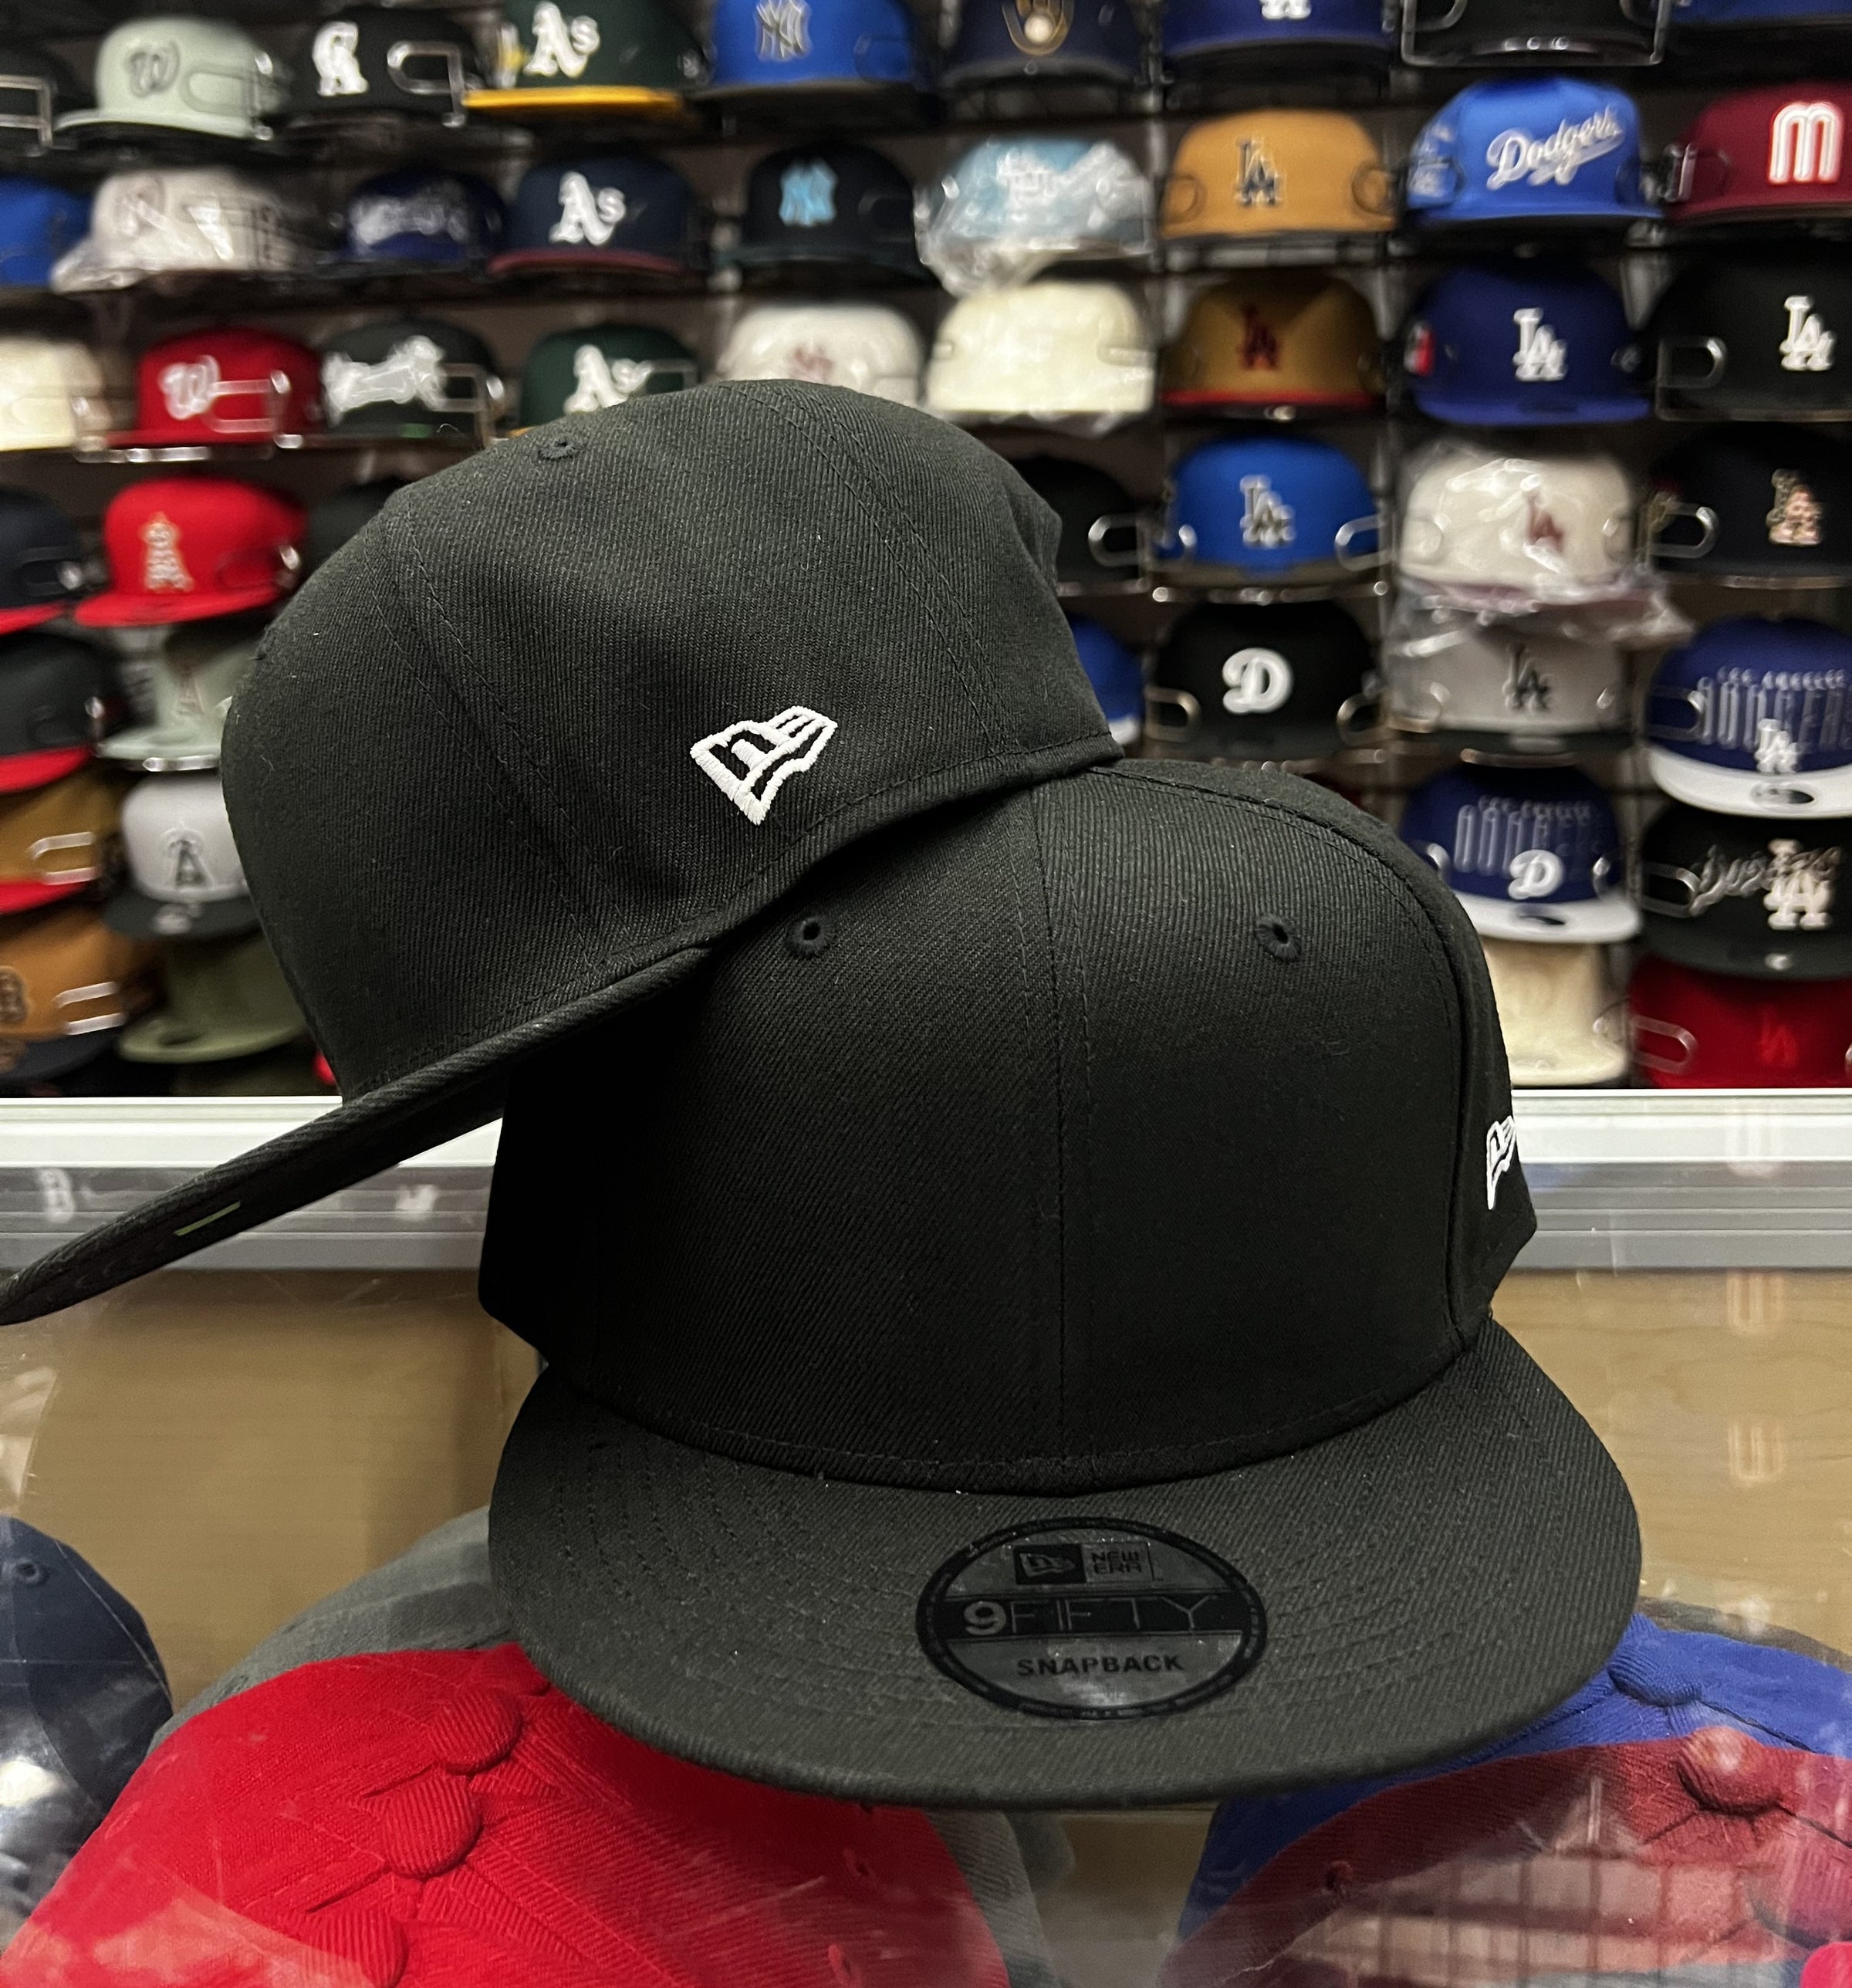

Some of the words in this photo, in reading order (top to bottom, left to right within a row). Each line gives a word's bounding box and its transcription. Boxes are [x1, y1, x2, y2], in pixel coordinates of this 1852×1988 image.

[1237, 135, 1283, 208] LA
[1486, 103, 1624, 190] Dodgers
[1512, 307, 1568, 381] LA
[1779, 295, 1837, 371] LA
[1239, 474, 1296, 549] LA
[1222, 647, 1293, 714] D
[1754, 718, 1801, 776] LA
[1508, 849, 1563, 900] D
[1090, 1550, 1140, 1562] NEW
[962, 1594, 1219, 1636] 9FIFTY
[1016, 1654, 1185, 1677] SNAPBACK
